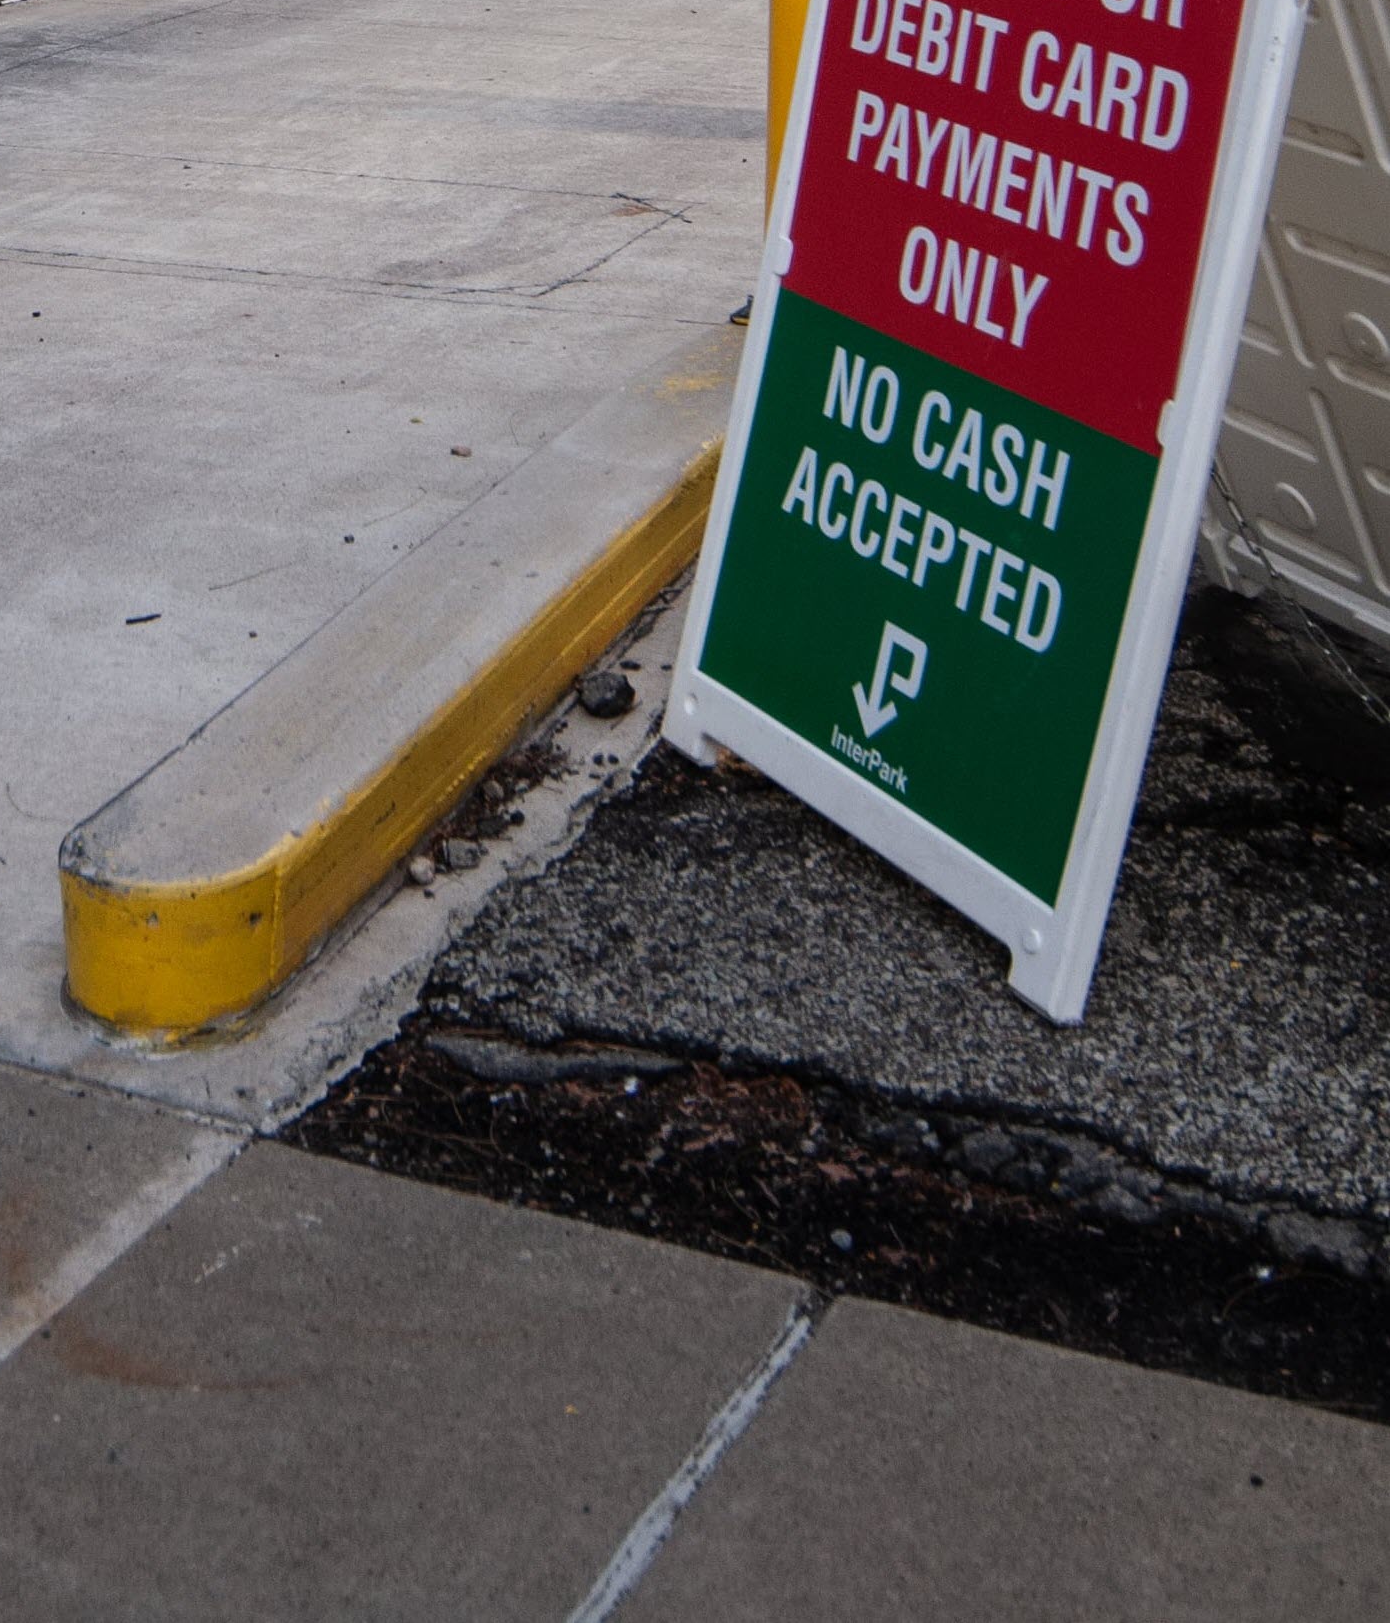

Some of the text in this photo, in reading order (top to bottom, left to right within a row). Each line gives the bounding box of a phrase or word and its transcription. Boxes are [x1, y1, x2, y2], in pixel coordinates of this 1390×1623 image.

[1019, 30, 1190, 151] CARD
[846, 89, 1149, 266] PAYMENTS
[899, 225, 1049, 348] ONLY
[823, 346, 1070, 529] NO CASH
[782, 446, 1062, 653] ACCEPTED
[830, 723, 909, 794] InterPark
